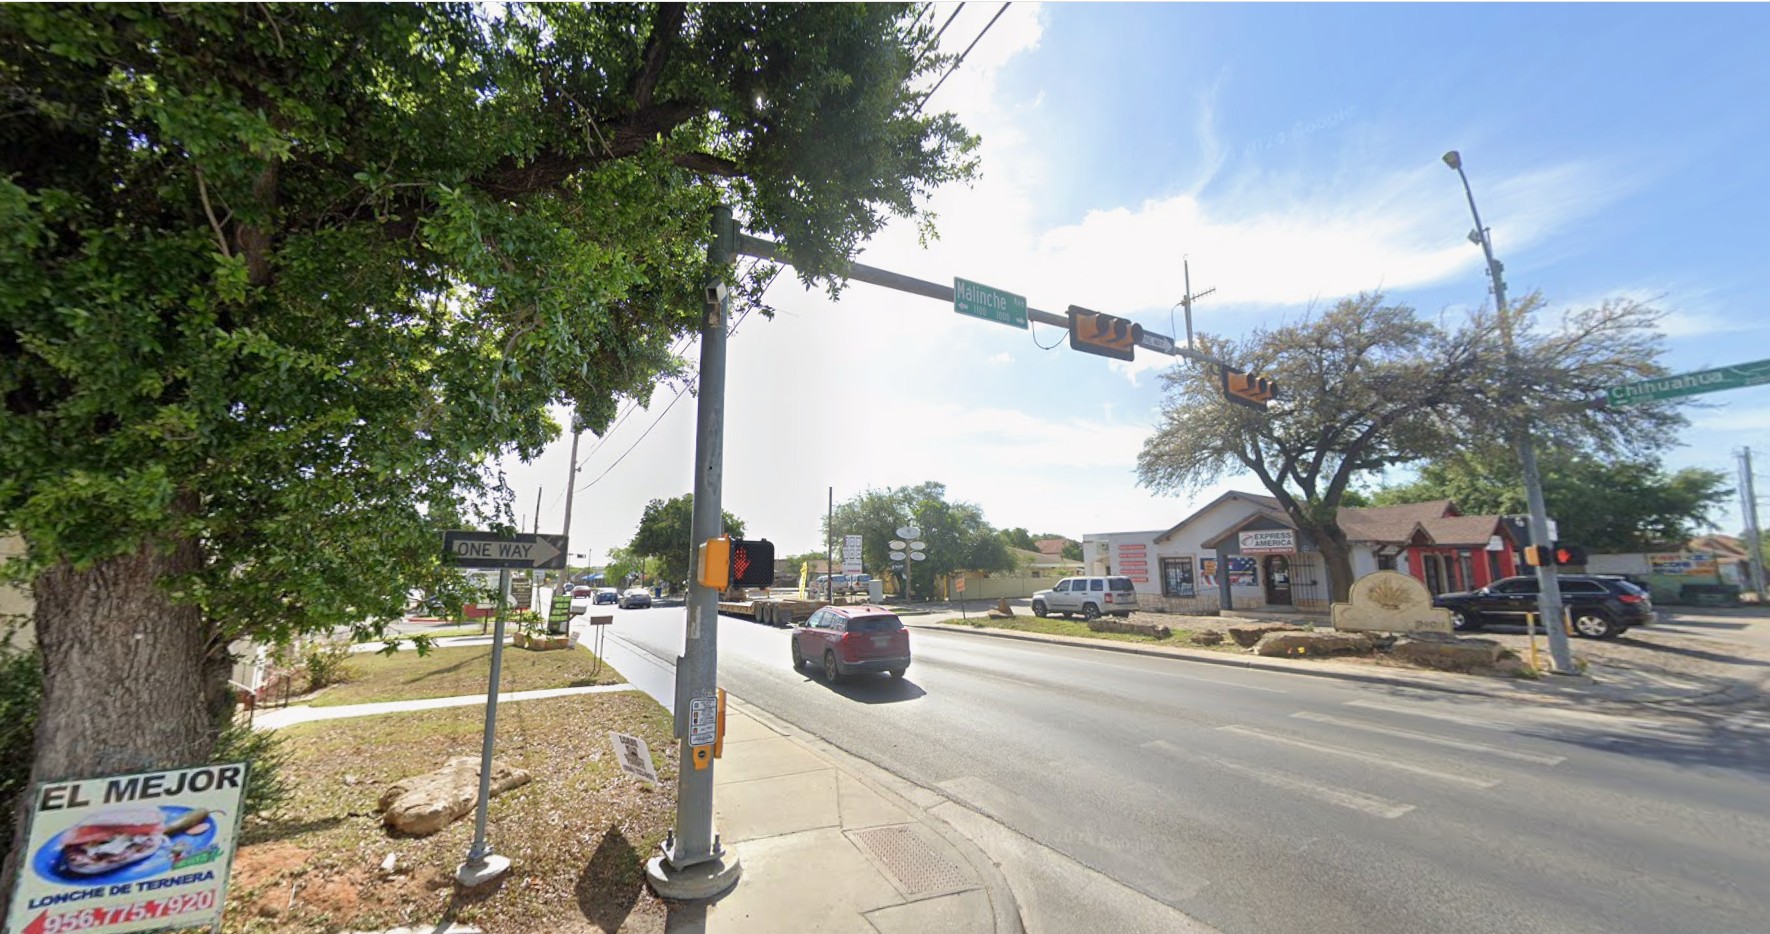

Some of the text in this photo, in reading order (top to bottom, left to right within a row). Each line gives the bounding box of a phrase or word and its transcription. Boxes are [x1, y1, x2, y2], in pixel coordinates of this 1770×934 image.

[957, 281, 1006, 310] Malinche
[457, 542, 533, 558] ONE WAY
[1254, 532, 1292, 540] EXPRESS
[1255, 539, 1292, 547] AMERICA
[38, 766, 241, 811] EL MEJOR
[28, 870, 215, 910] LONCHE DE TERNERA
[42, 890, 214, 933] 956.775.7920
